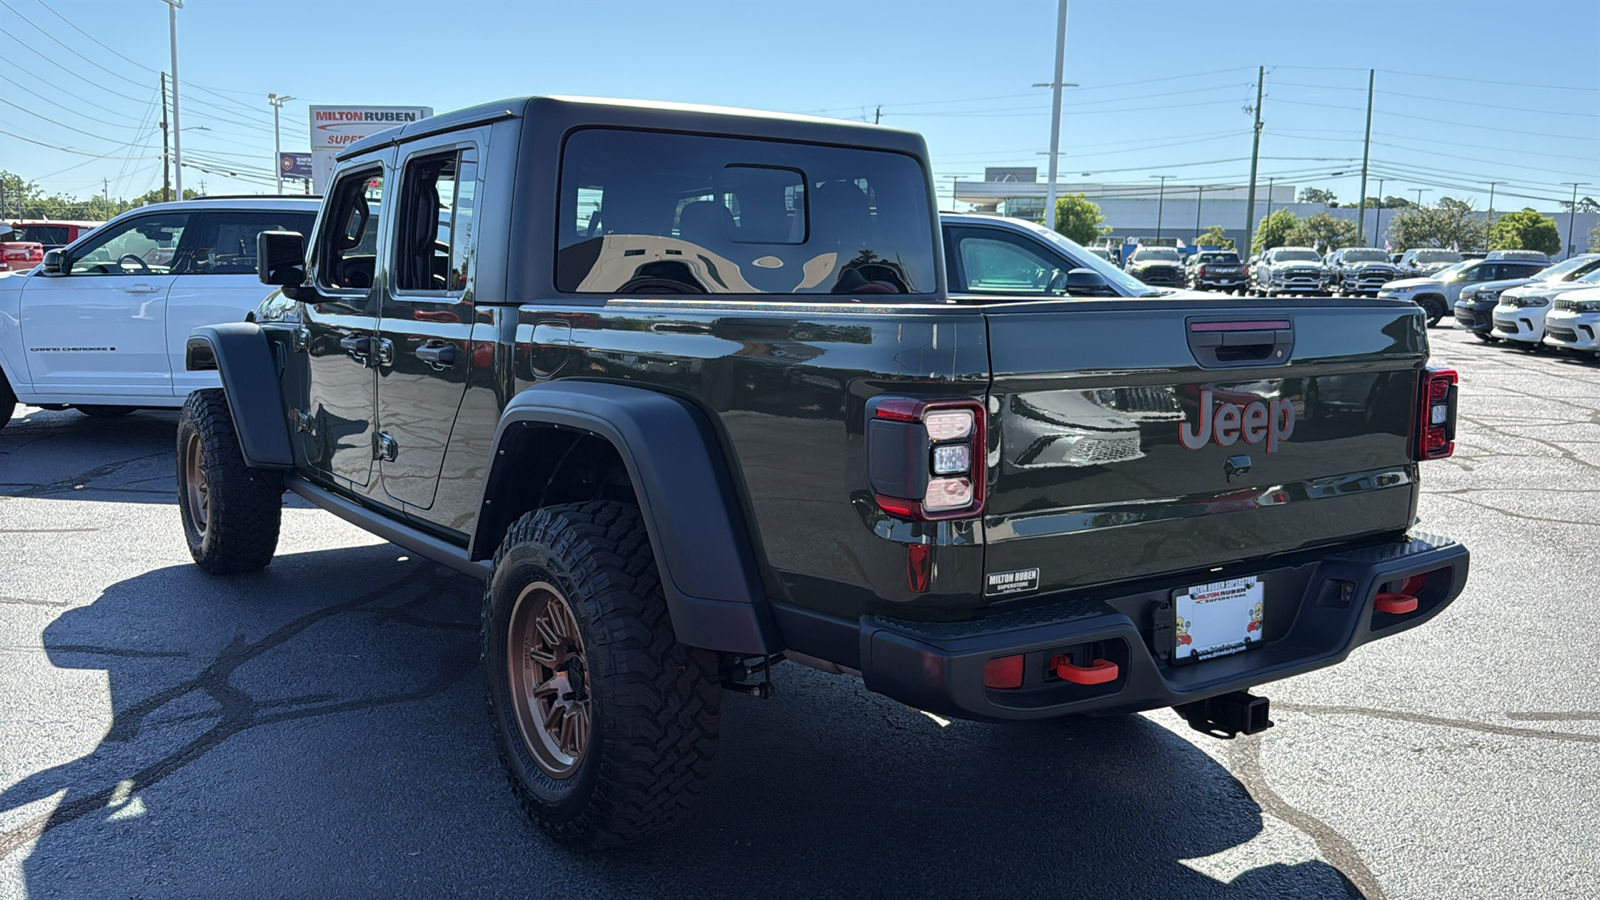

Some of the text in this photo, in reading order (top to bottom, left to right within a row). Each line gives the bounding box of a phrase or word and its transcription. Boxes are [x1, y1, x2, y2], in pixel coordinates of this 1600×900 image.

[315, 111, 416, 122] MILTON RUBEN
[327, 134, 365, 144] SUPE
[1178, 390, 1295, 454] Jeep
[988, 570, 1037, 585] MILTON RUBEN
[996, 581, 1029, 591] SUPERSTORE
[1220, 587, 1247, 597] RUBEN
[1204, 593, 1247, 604] SUPERSTORE
